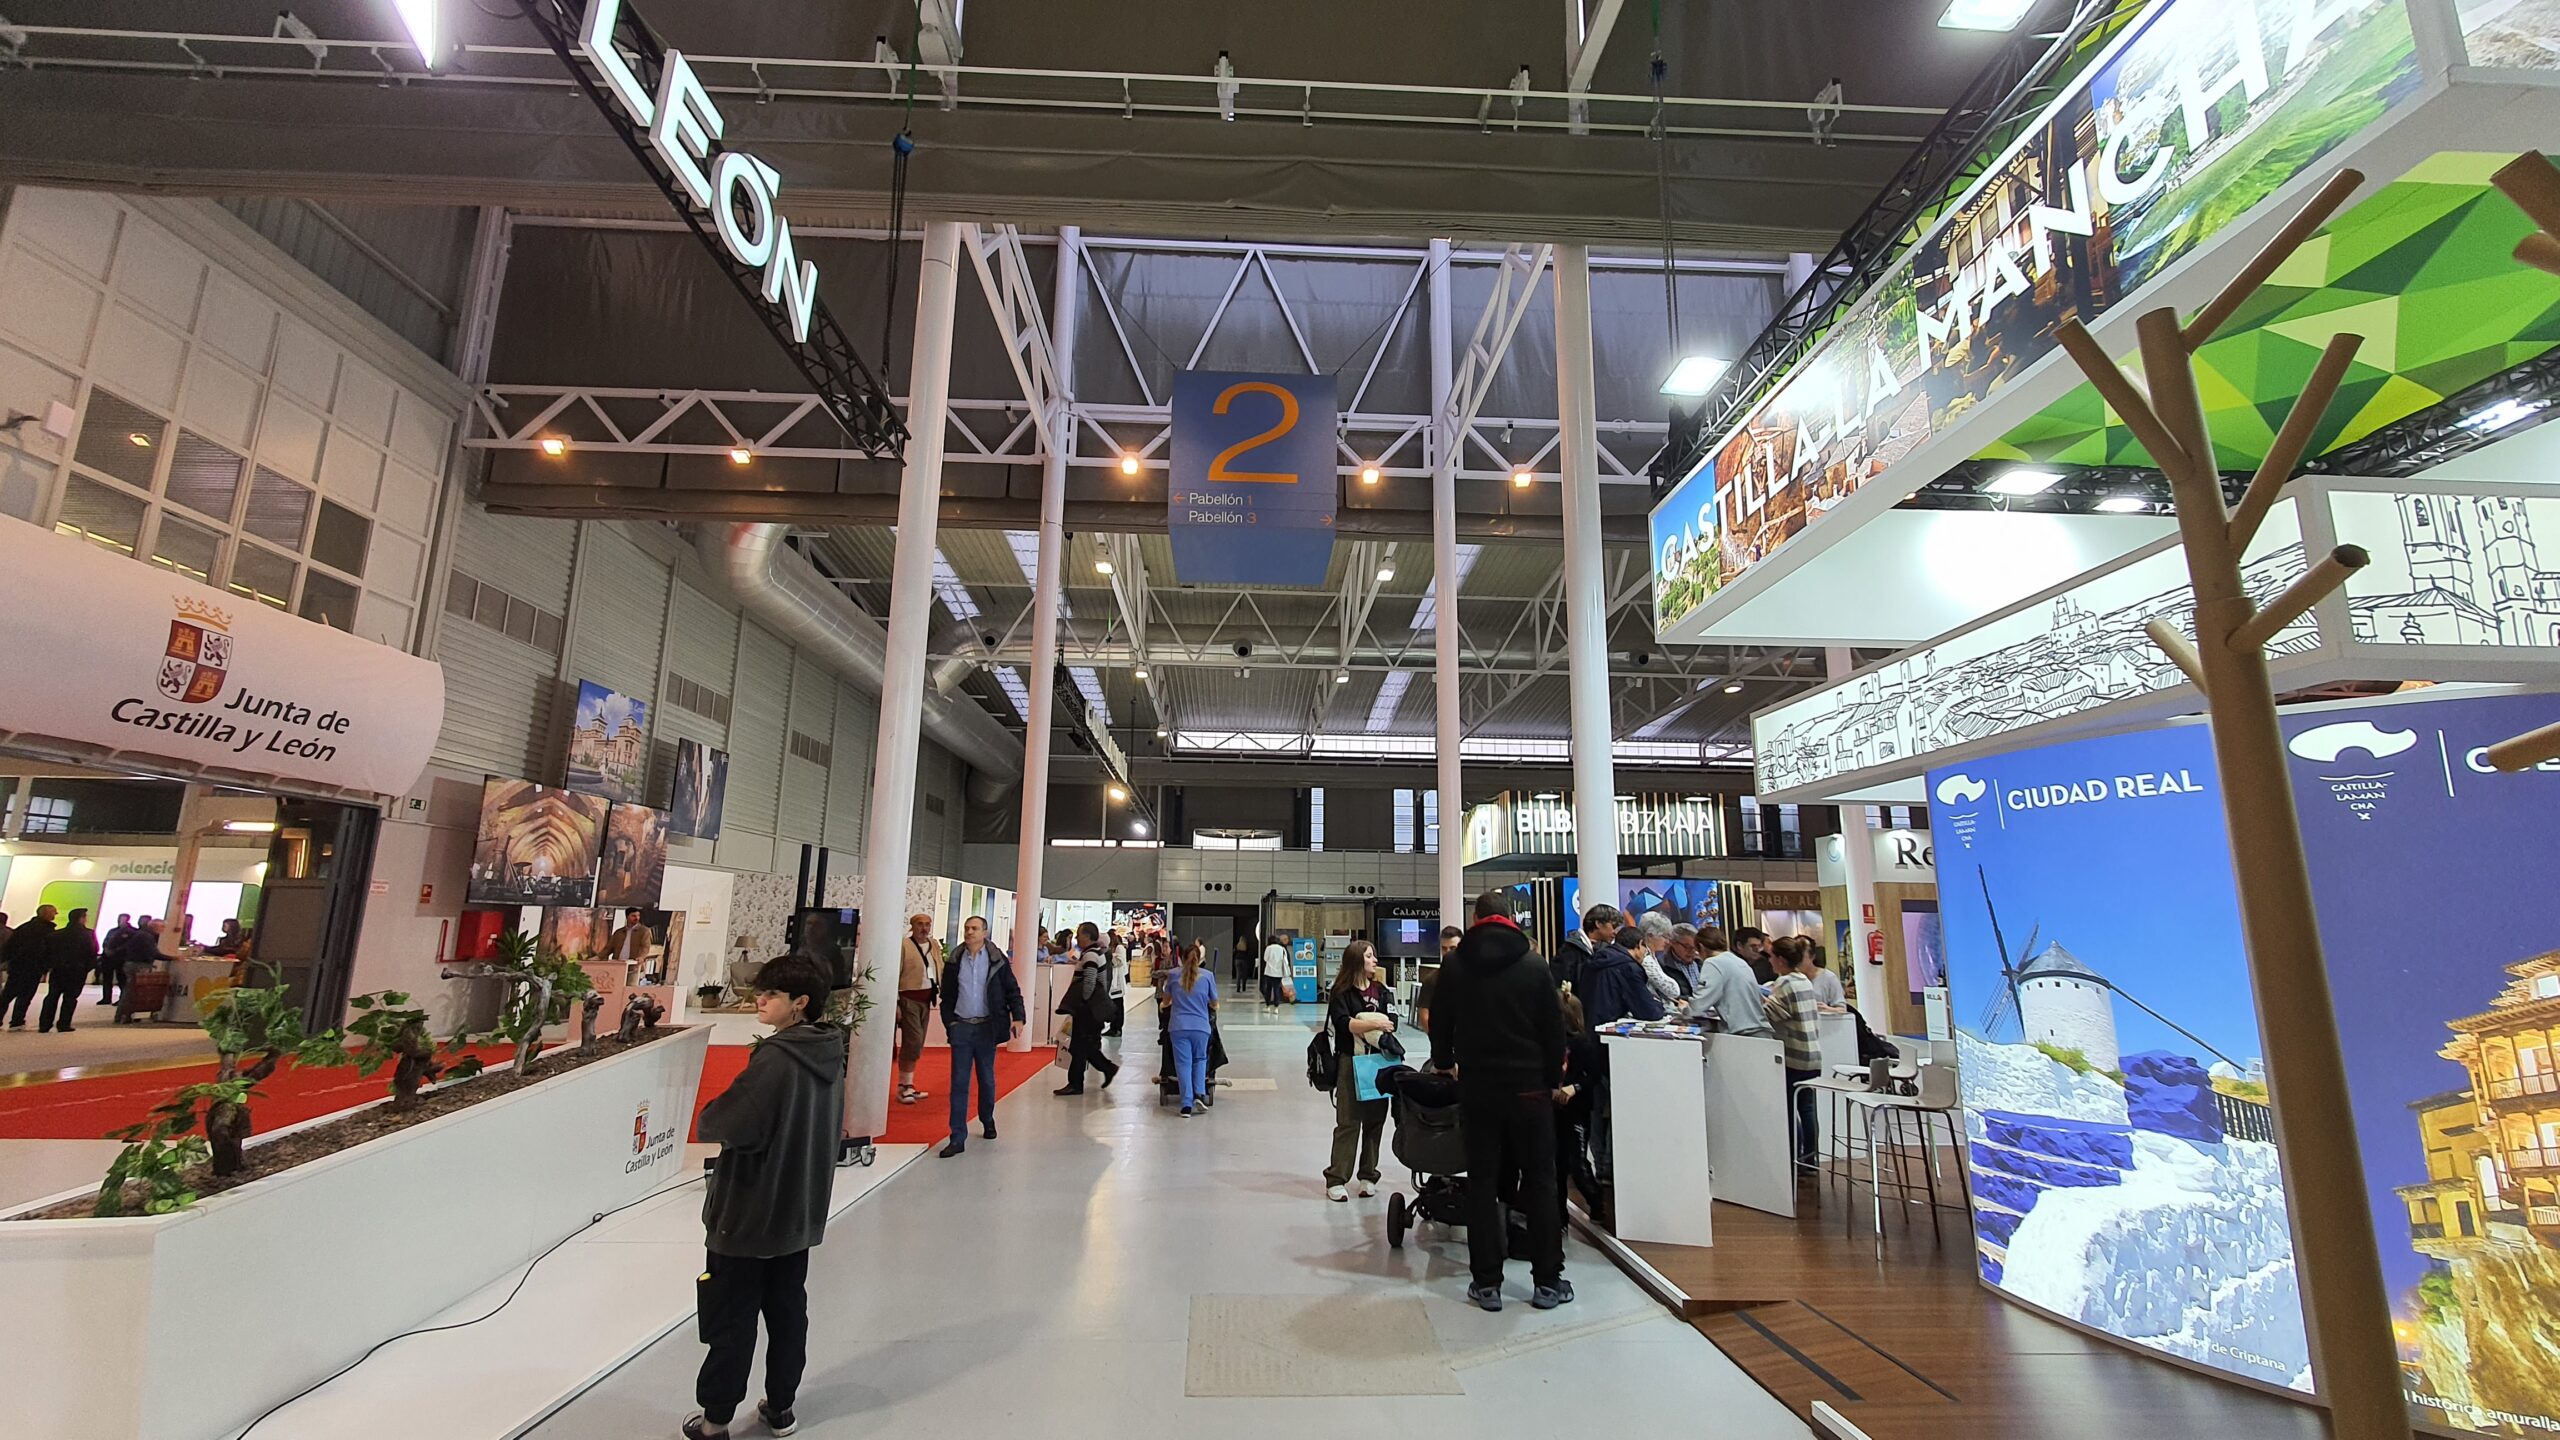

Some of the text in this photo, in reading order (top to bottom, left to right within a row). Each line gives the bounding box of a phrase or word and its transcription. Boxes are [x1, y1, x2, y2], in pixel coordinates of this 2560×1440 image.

[1207, 381, 1299, 483] 2
[1189, 492, 1252, 505] Pabellón 1
[1188, 510, 1257, 524] Pabellón 3
[224, 687, 350, 735] Junta de
[111, 698, 337, 762] Castilla y León
[2007, 769, 2204, 810] CIUDAD REAL
[1517, 808, 1576, 832] BILB
[1619, 811, 1715, 834] BIZKAIA
[1754, 894, 1790, 906] RABA
[646, 1126, 675, 1149] Junta de
[625, 1155, 650, 1174] Castilla
[657, 1143, 673, 1159] León
[2211, 1342, 2228, 1355] de
[2229, 1347, 2287, 1372] Criptana
